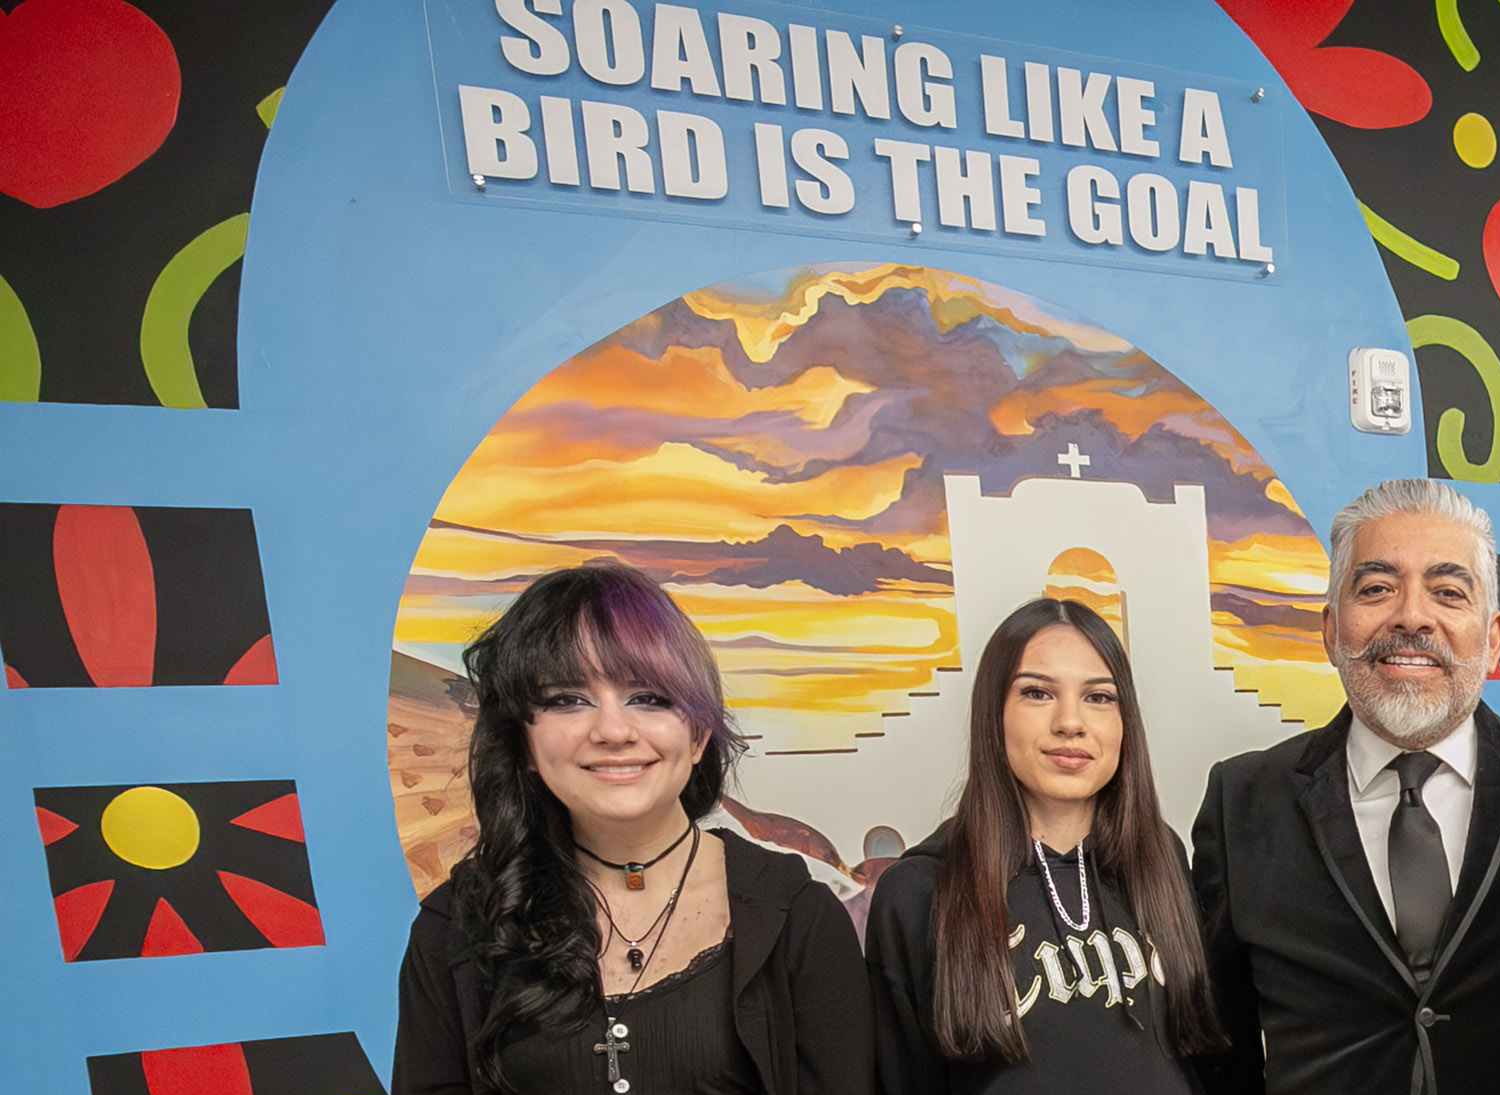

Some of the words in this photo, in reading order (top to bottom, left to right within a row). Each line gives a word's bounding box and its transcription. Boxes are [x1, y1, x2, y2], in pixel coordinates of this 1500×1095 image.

[496, 0, 957, 129] SOARING
[979, 54, 1162, 159] LIKE
[1178, 88, 1234, 169] A
[458, 85, 729, 201] BIRD
[754, 124, 857, 215] IS
[874, 138, 1047, 237] THE
[1066, 166, 1274, 262] GOAL
